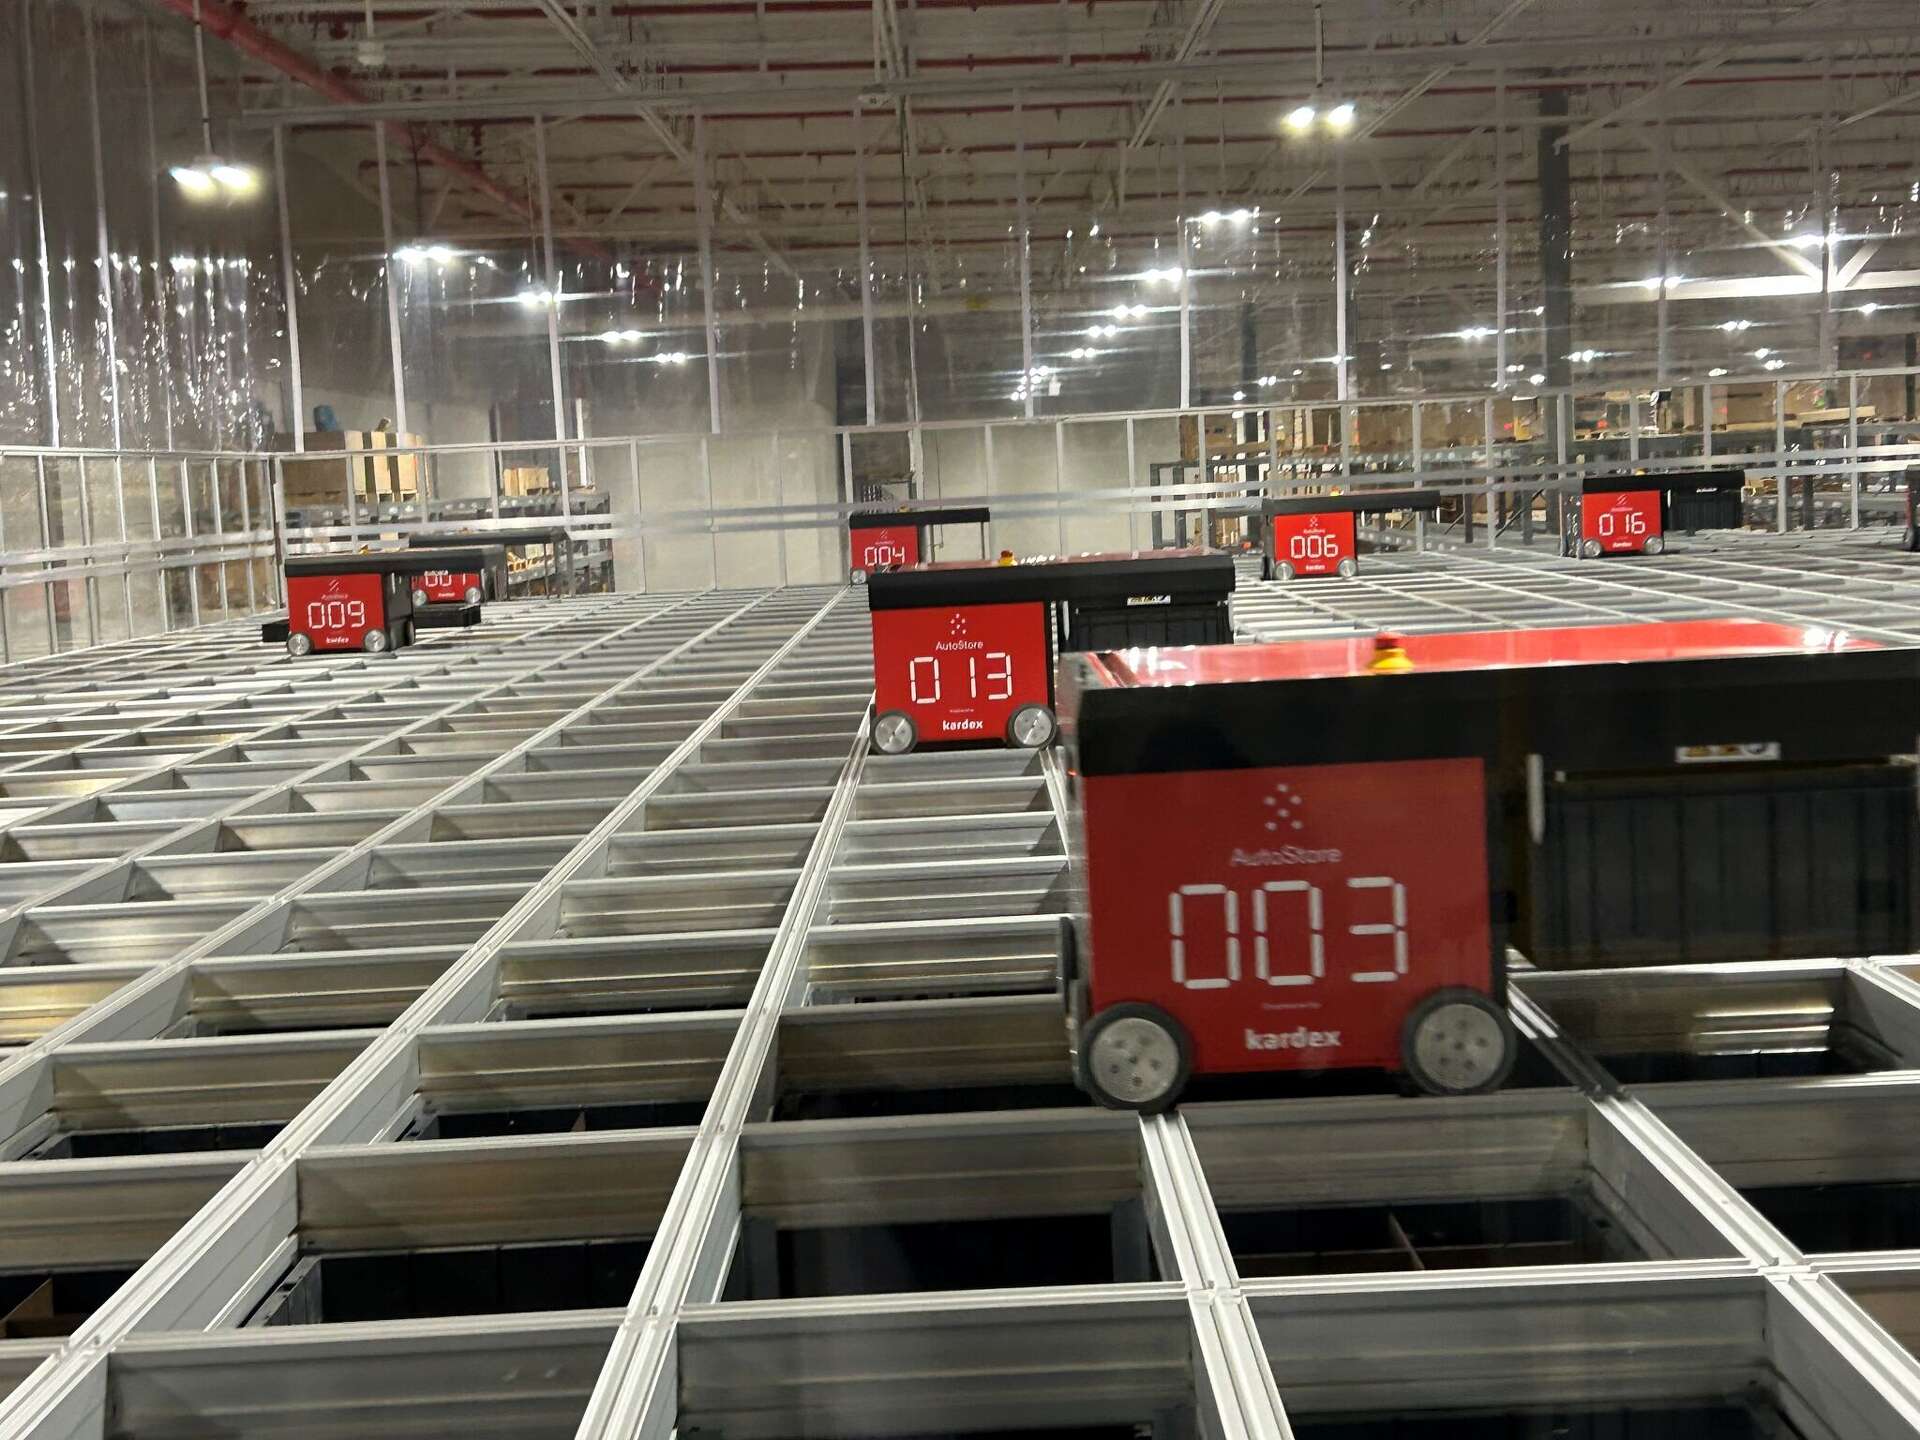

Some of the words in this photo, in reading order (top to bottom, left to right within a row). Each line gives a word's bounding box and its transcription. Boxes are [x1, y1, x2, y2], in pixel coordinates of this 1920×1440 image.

[1599, 512, 1646, 536] 016
[864, 546, 905, 566] 004
[1290, 533, 1339, 559] 006
[307, 600, 365, 629] 009
[935, 639, 984, 651] AutoStore
[909, 652, 1013, 704] 013
[942, 718, 984, 731] kardex
[1231, 845, 1342, 867] AutoStore
[1169, 876, 1409, 990] 003
[1245, 1026, 1341, 1050] kardex
